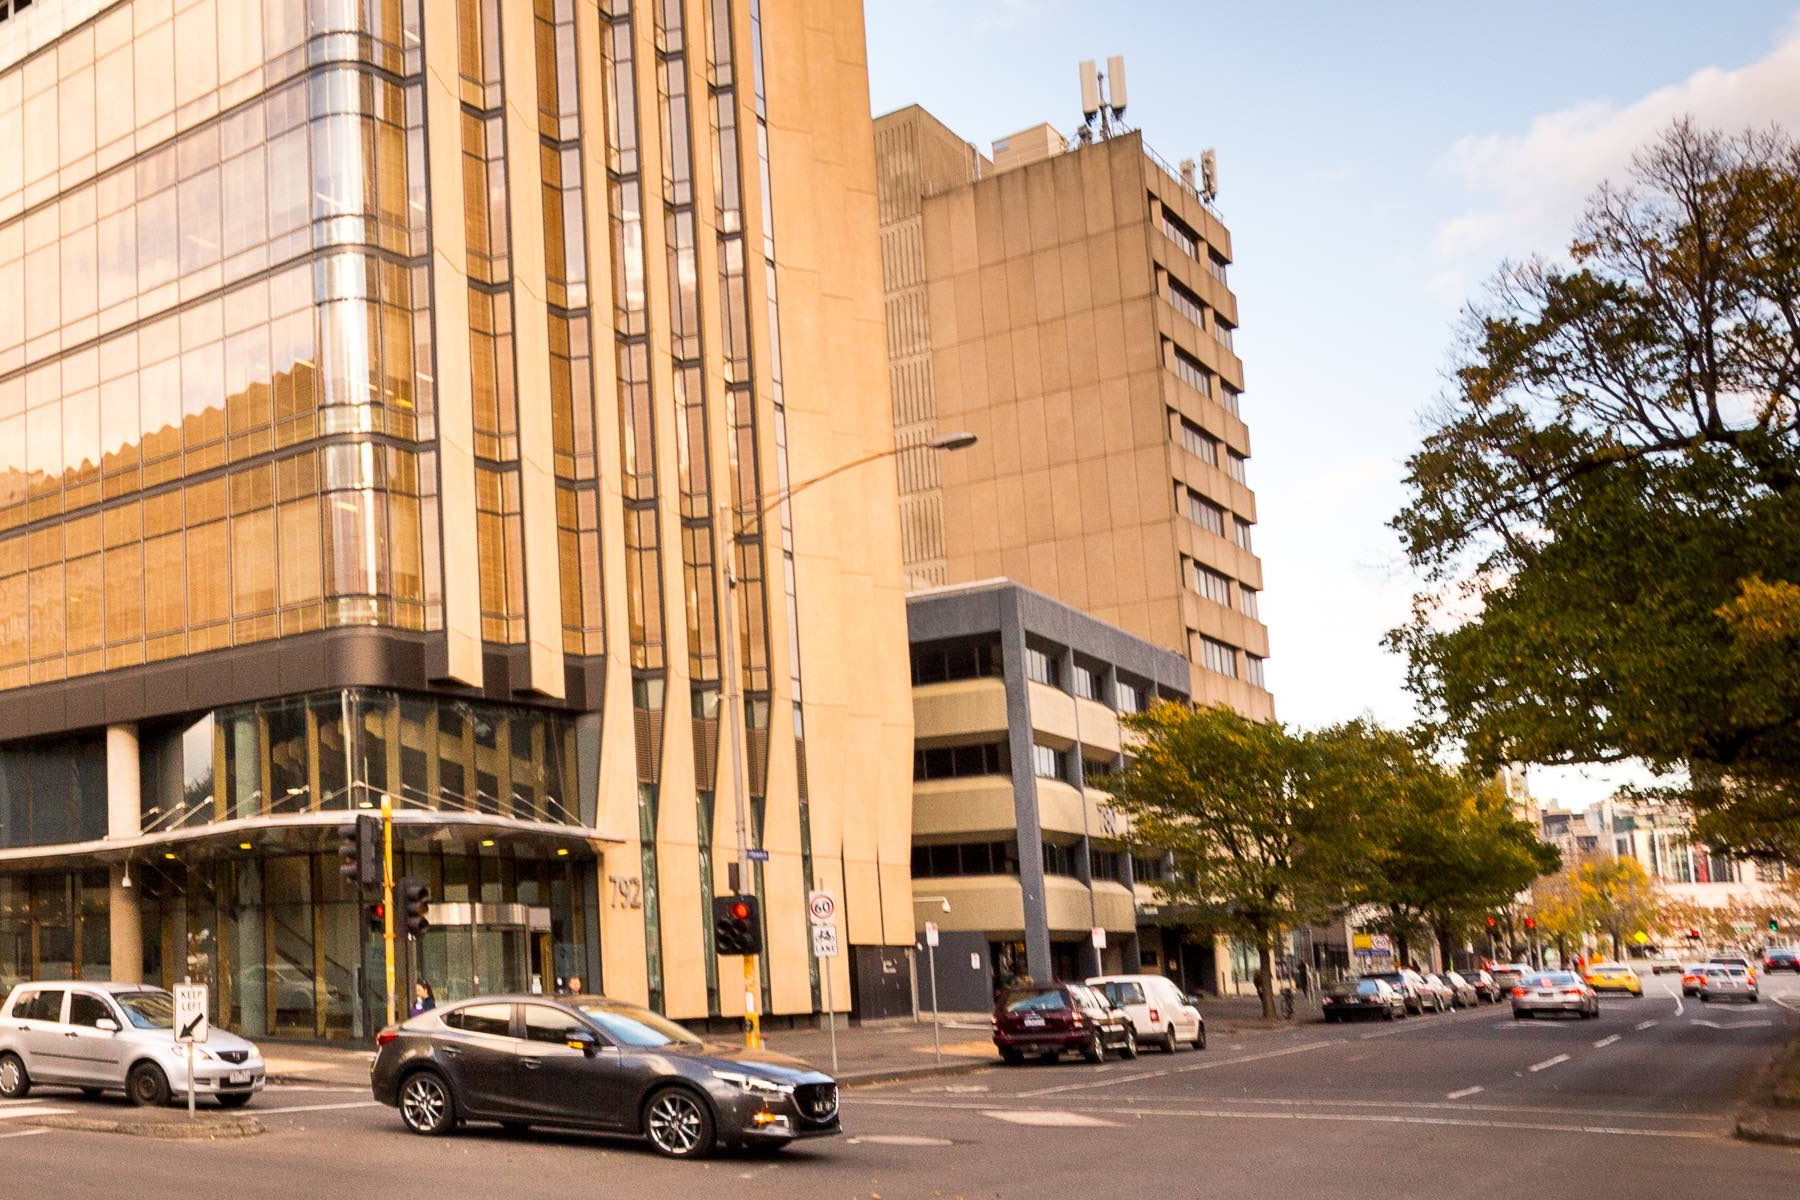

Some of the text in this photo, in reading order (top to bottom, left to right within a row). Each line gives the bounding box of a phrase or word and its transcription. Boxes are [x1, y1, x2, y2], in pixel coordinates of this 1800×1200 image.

[609, 875, 641, 910] 792
[814, 901, 831, 914] 60
[815, 945, 836, 954] LANE
[181, 991, 203, 1000] KEEP
[181, 1001, 202, 1011] LEFT
